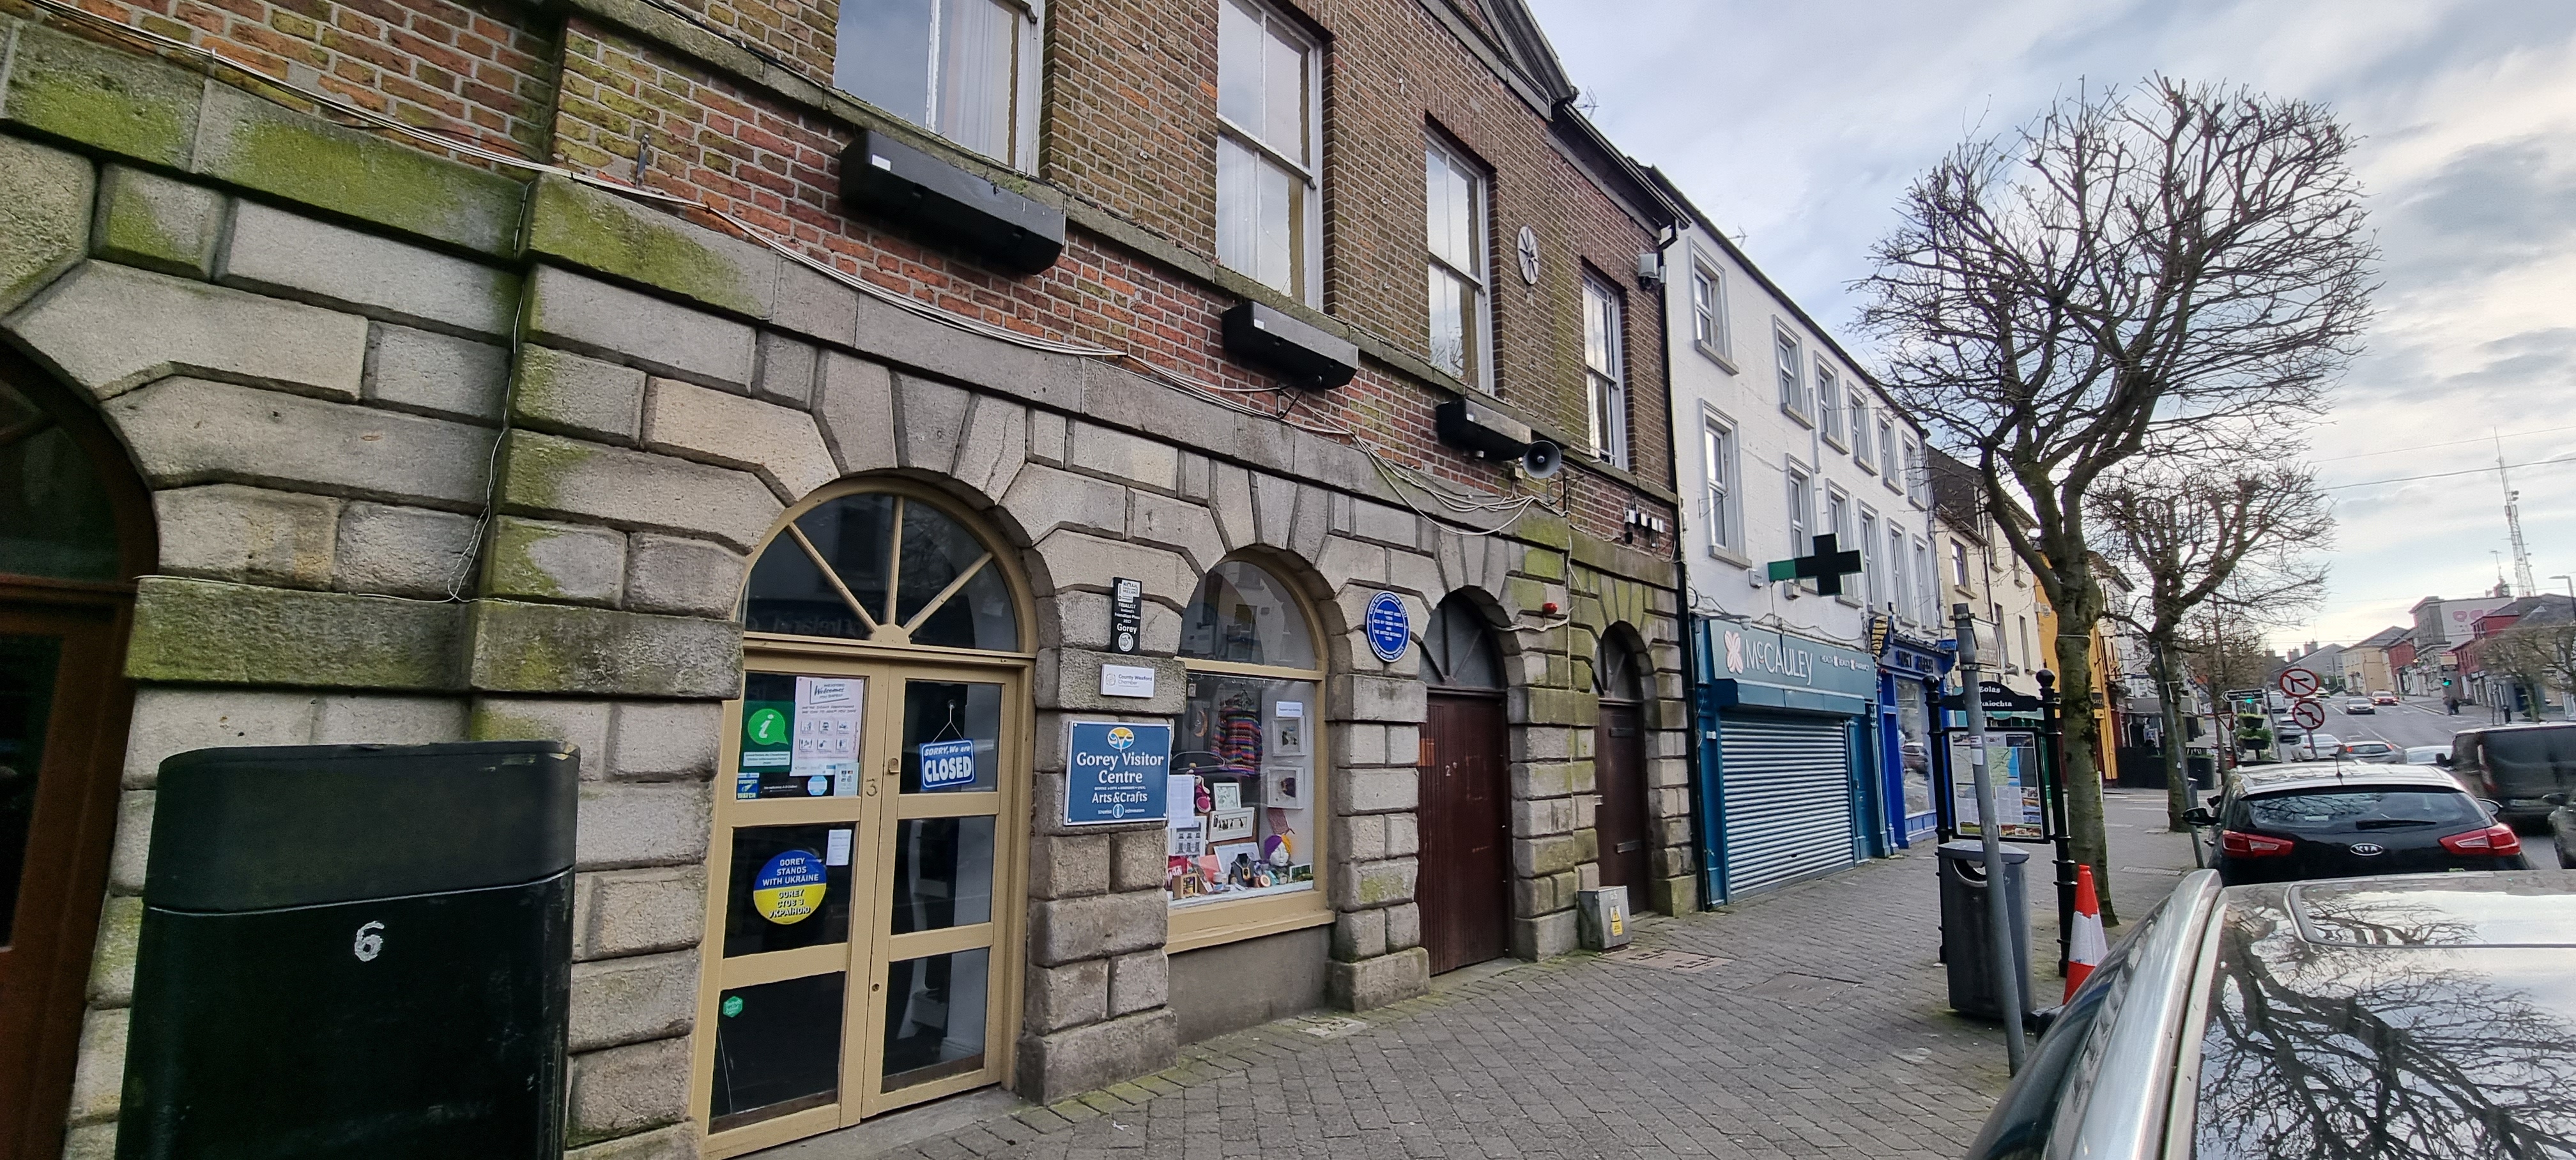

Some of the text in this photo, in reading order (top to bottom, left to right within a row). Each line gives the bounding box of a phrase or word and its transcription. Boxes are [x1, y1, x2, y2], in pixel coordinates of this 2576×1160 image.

[1117, 623, 1137, 634] Gorey
[1077, 752, 1164, 770] Gorey Visitor
[924, 756, 972, 782] CLOSED
[1445, 765, 1451, 777] 2
[1098, 770, 1143, 784] Centre
[866, 779, 878, 797] 3
[779, 857, 805, 867] GOREY
[776, 866, 807, 876] STANDS
[762, 873, 819, 887] WITH UKRAINE
[779, 889, 804, 899] GOREY
[355, 920, 385, 962] 6
